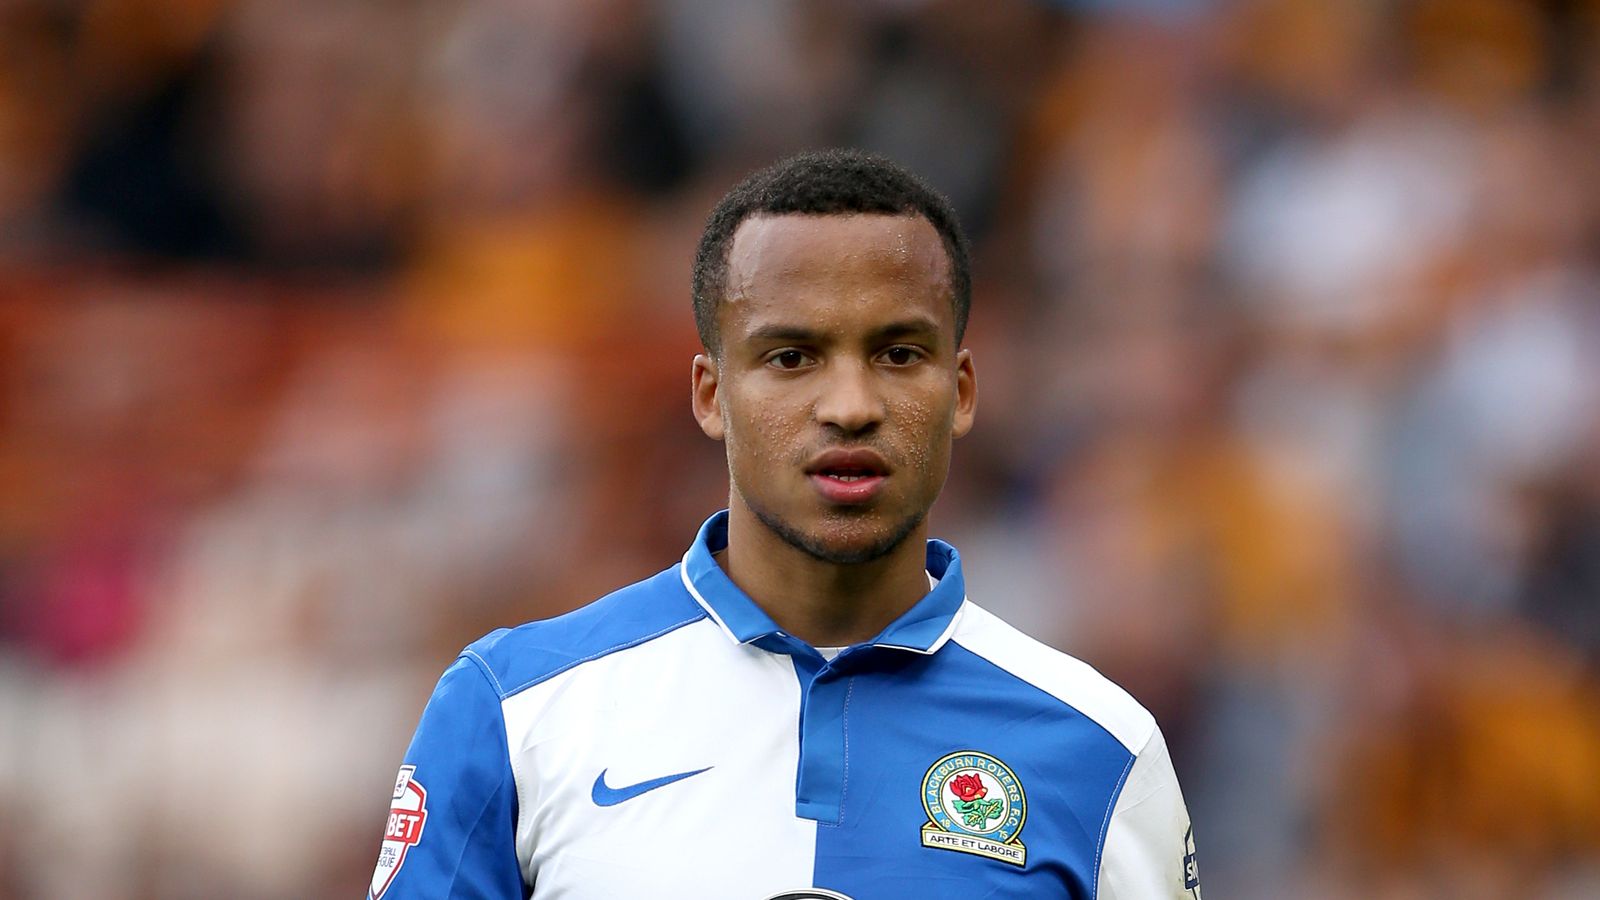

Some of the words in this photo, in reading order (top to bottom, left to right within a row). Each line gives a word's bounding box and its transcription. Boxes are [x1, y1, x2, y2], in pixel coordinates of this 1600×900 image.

[927, 757, 974, 814] BLACKBURN
[977, 758, 1020, 802] ROVERS
[930, 835, 959, 846] ARTE
[962, 839, 976, 848] ET
[978, 842, 1020, 859] LABORE
